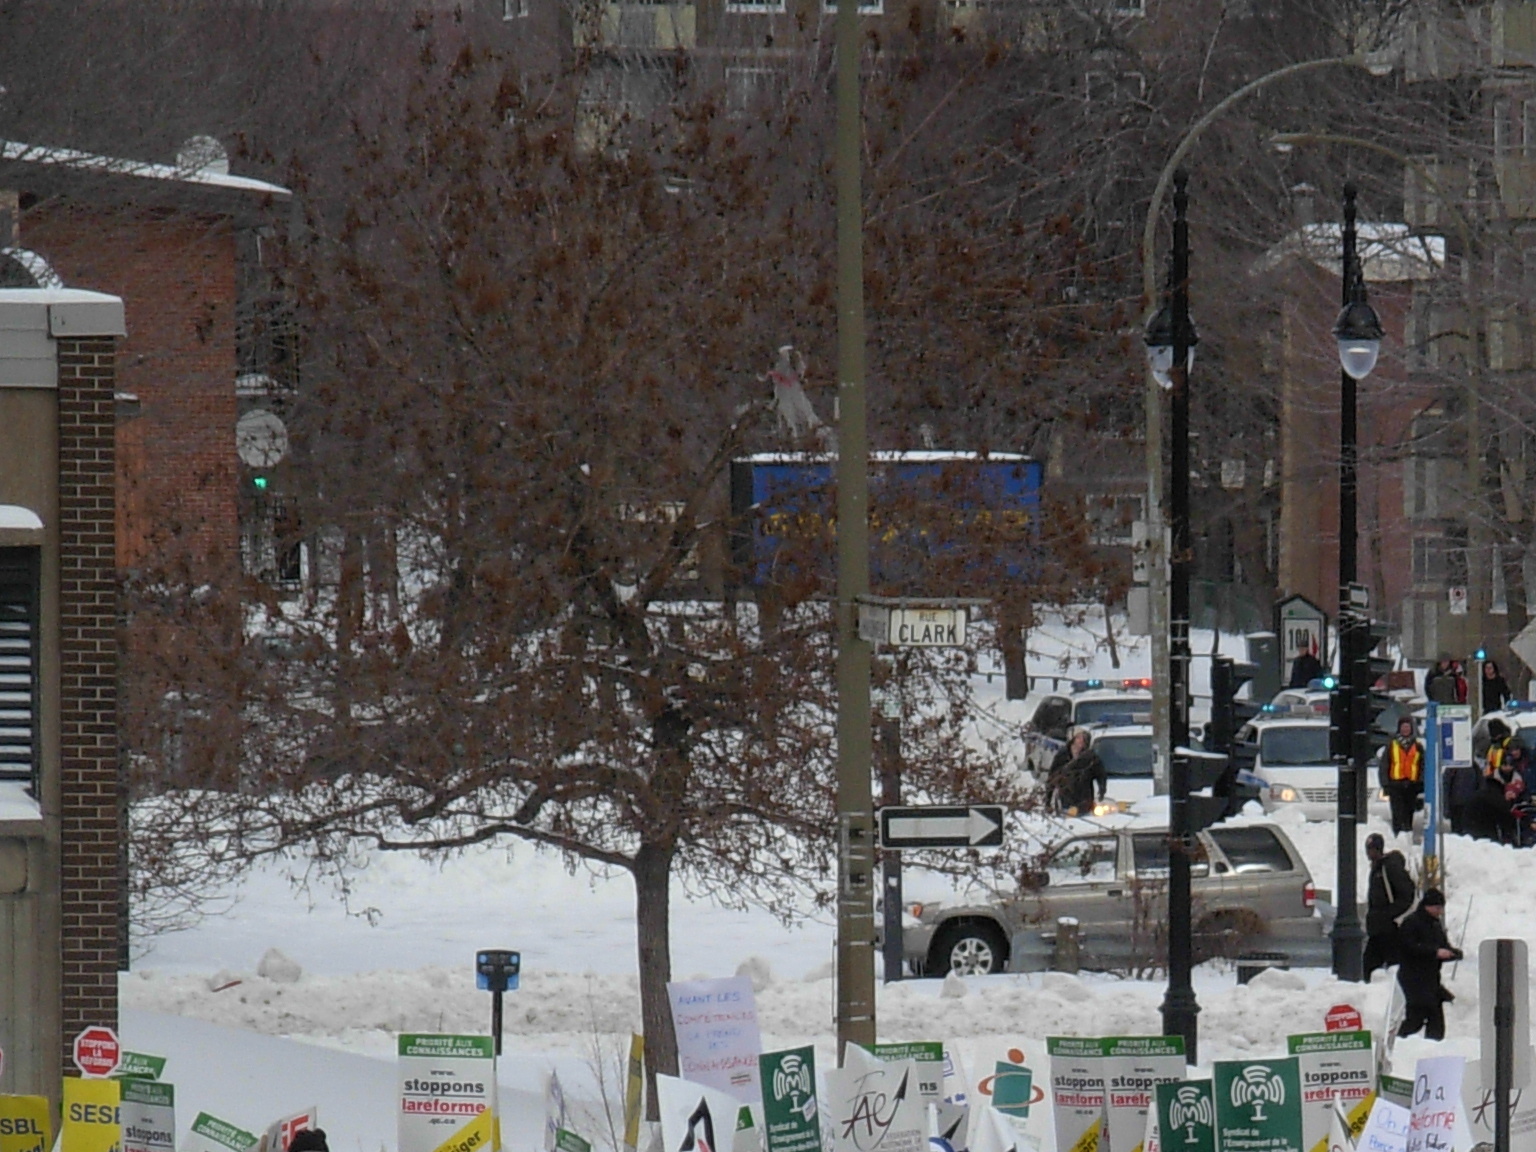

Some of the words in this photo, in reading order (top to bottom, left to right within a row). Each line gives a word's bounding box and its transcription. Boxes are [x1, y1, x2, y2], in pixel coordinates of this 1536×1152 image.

[919, 612, 936, 621] RUE
[899, 624, 957, 643] CLARK
[1053, 1047, 1103, 1056] CONNAISSANCE
[1054, 1076, 1104, 1089] stoppon
[1305, 1069, 1368, 1083] toppons
[404, 1079, 484, 1095] stoppons
[1054, 1091, 1104, 1105] lareform
[402, 1098, 486, 1114] lareforme
[0, 1118, 43, 1134] SBL
[125, 1126, 173, 1143] stoppons
